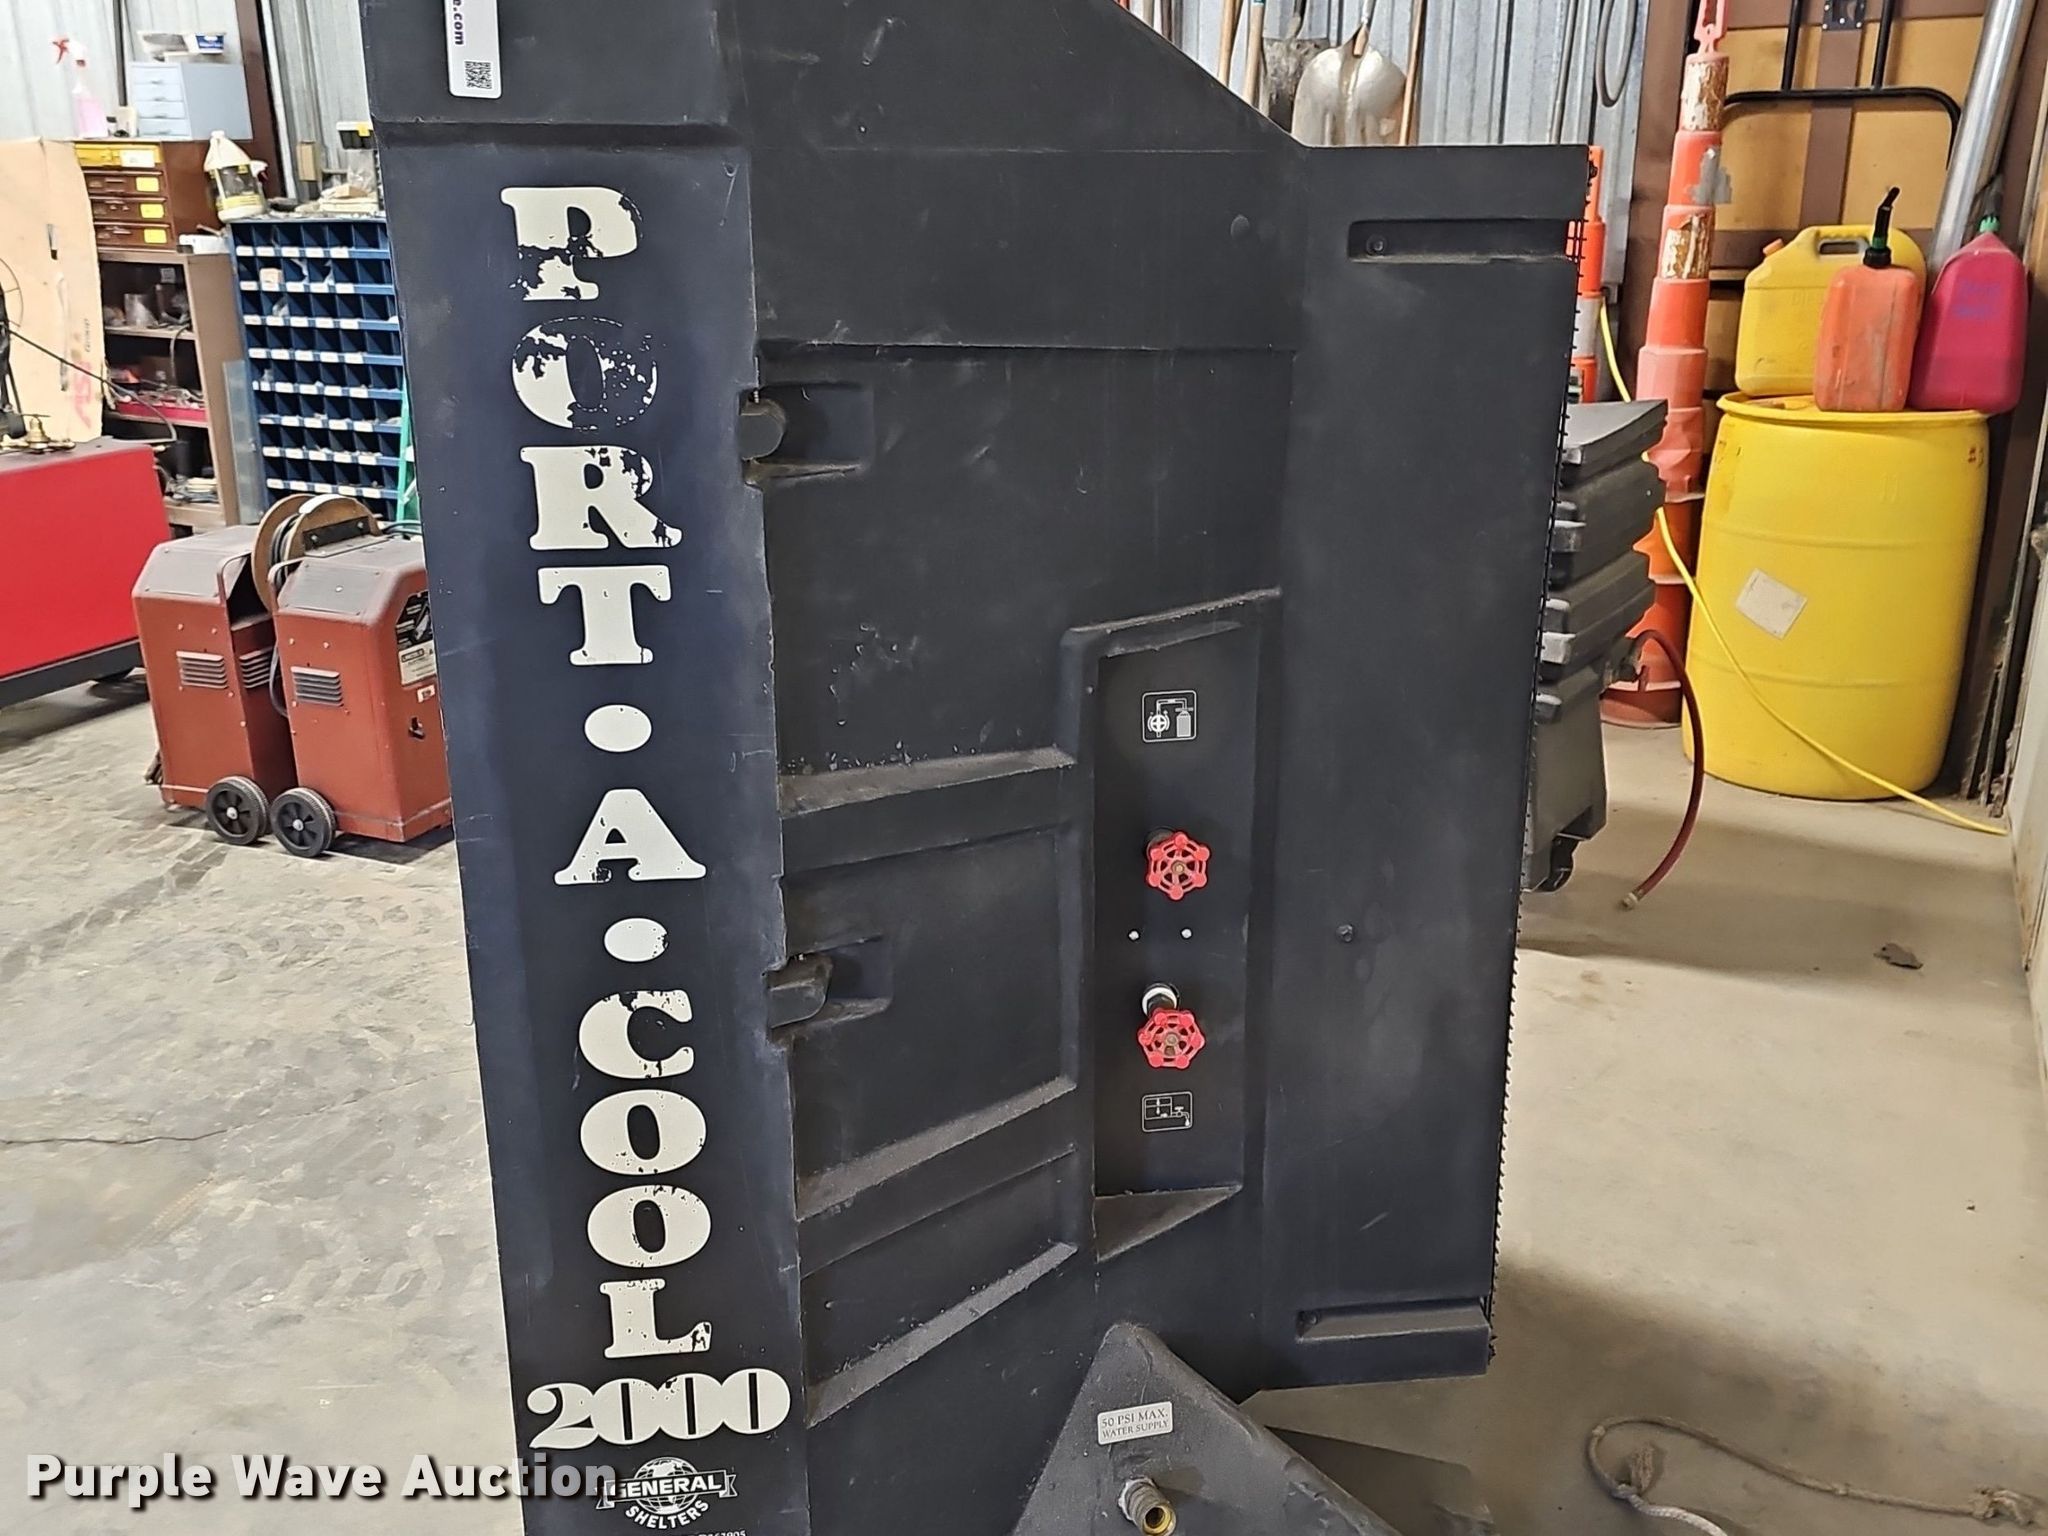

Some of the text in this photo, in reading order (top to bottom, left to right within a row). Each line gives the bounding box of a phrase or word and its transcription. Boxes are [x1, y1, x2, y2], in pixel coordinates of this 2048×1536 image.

[526, 1367, 791, 1450] 2000
[1102, 1408, 1169, 1428] 50 PSI MAX.
[1102, 1420, 1169, 1438] WATER SUPPLY
[625, 1500, 709, 1530] SHELTERS
